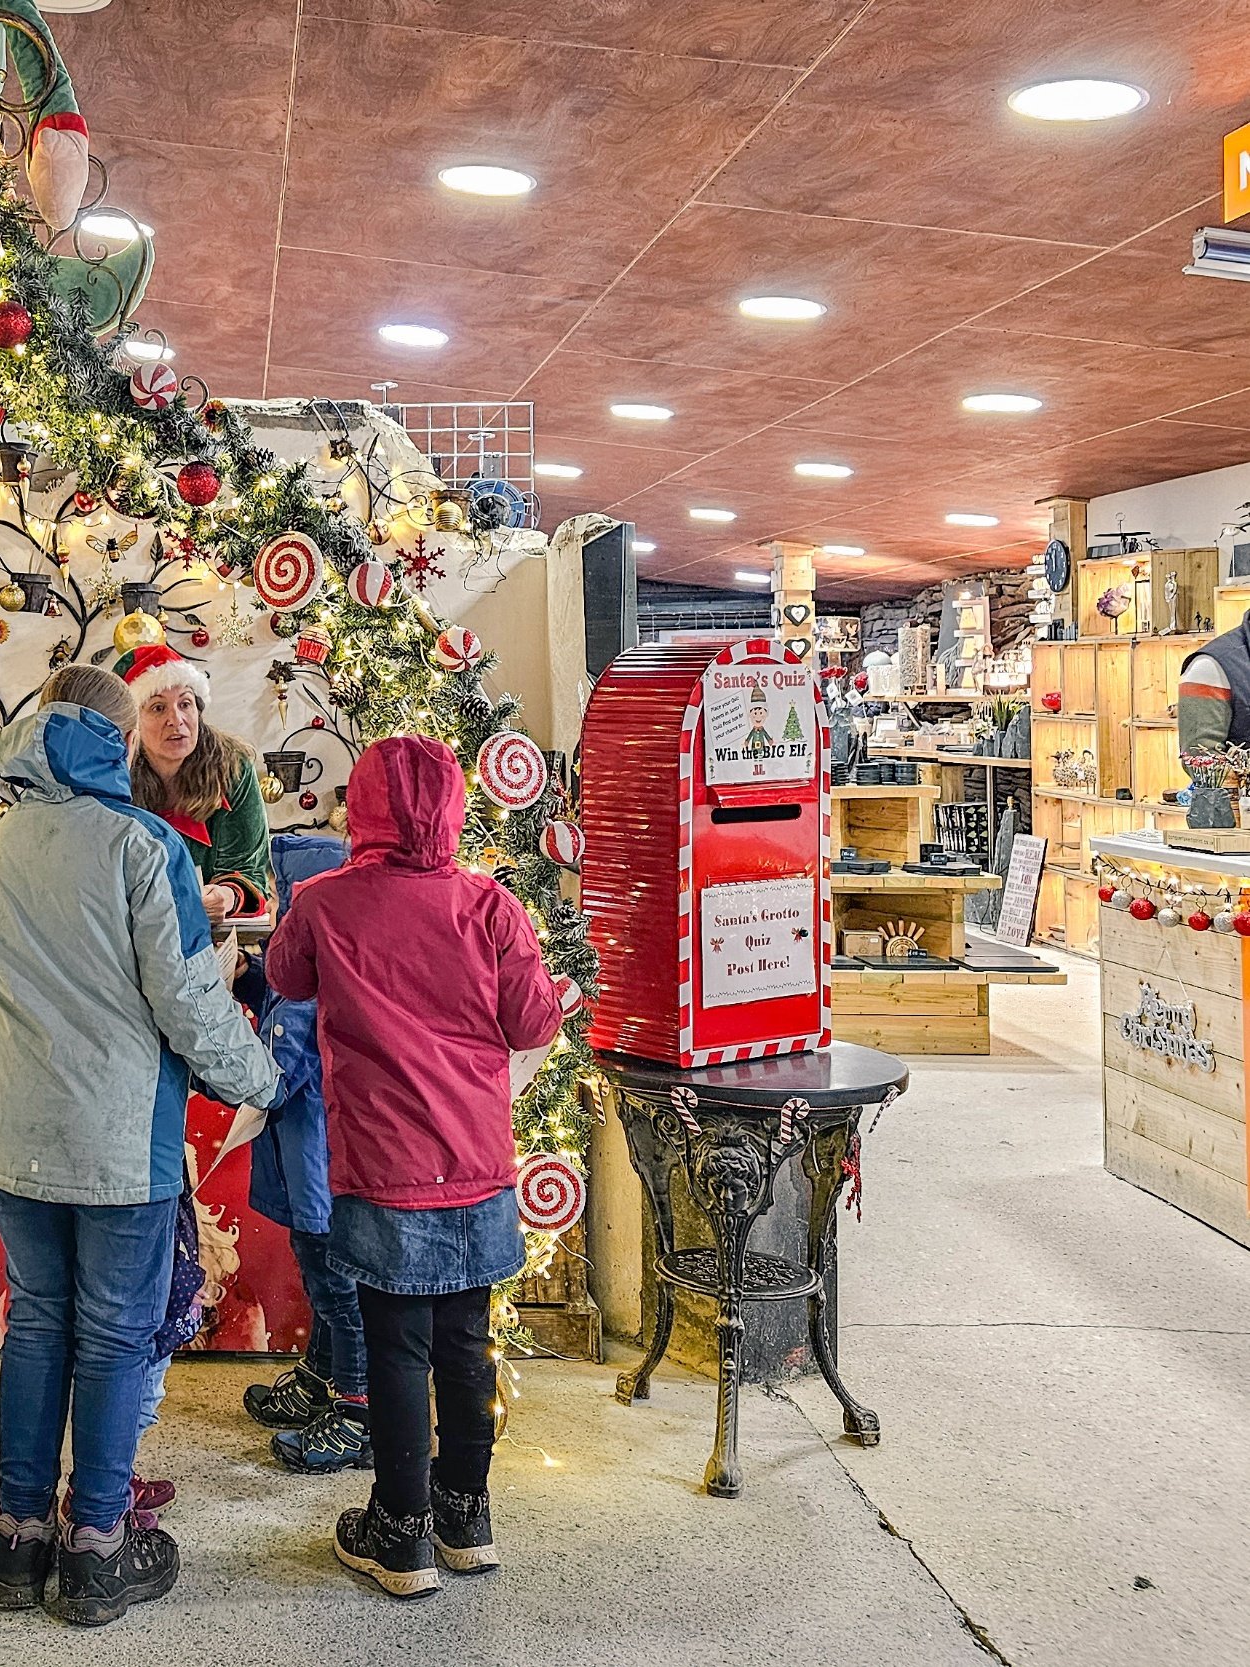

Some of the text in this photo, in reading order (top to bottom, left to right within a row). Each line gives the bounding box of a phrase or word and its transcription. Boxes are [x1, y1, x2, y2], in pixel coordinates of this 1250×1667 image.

[714, 670, 806, 690] Santa's Quiz
[715, 744, 807, 762] Win the BIG Elf
[714, 908, 800, 928] Santa's Grotto
[745, 933, 771, 951] Quiz
[1006, 926, 1025, 940] LOVE
[726, 955, 790, 976] Post Here!
